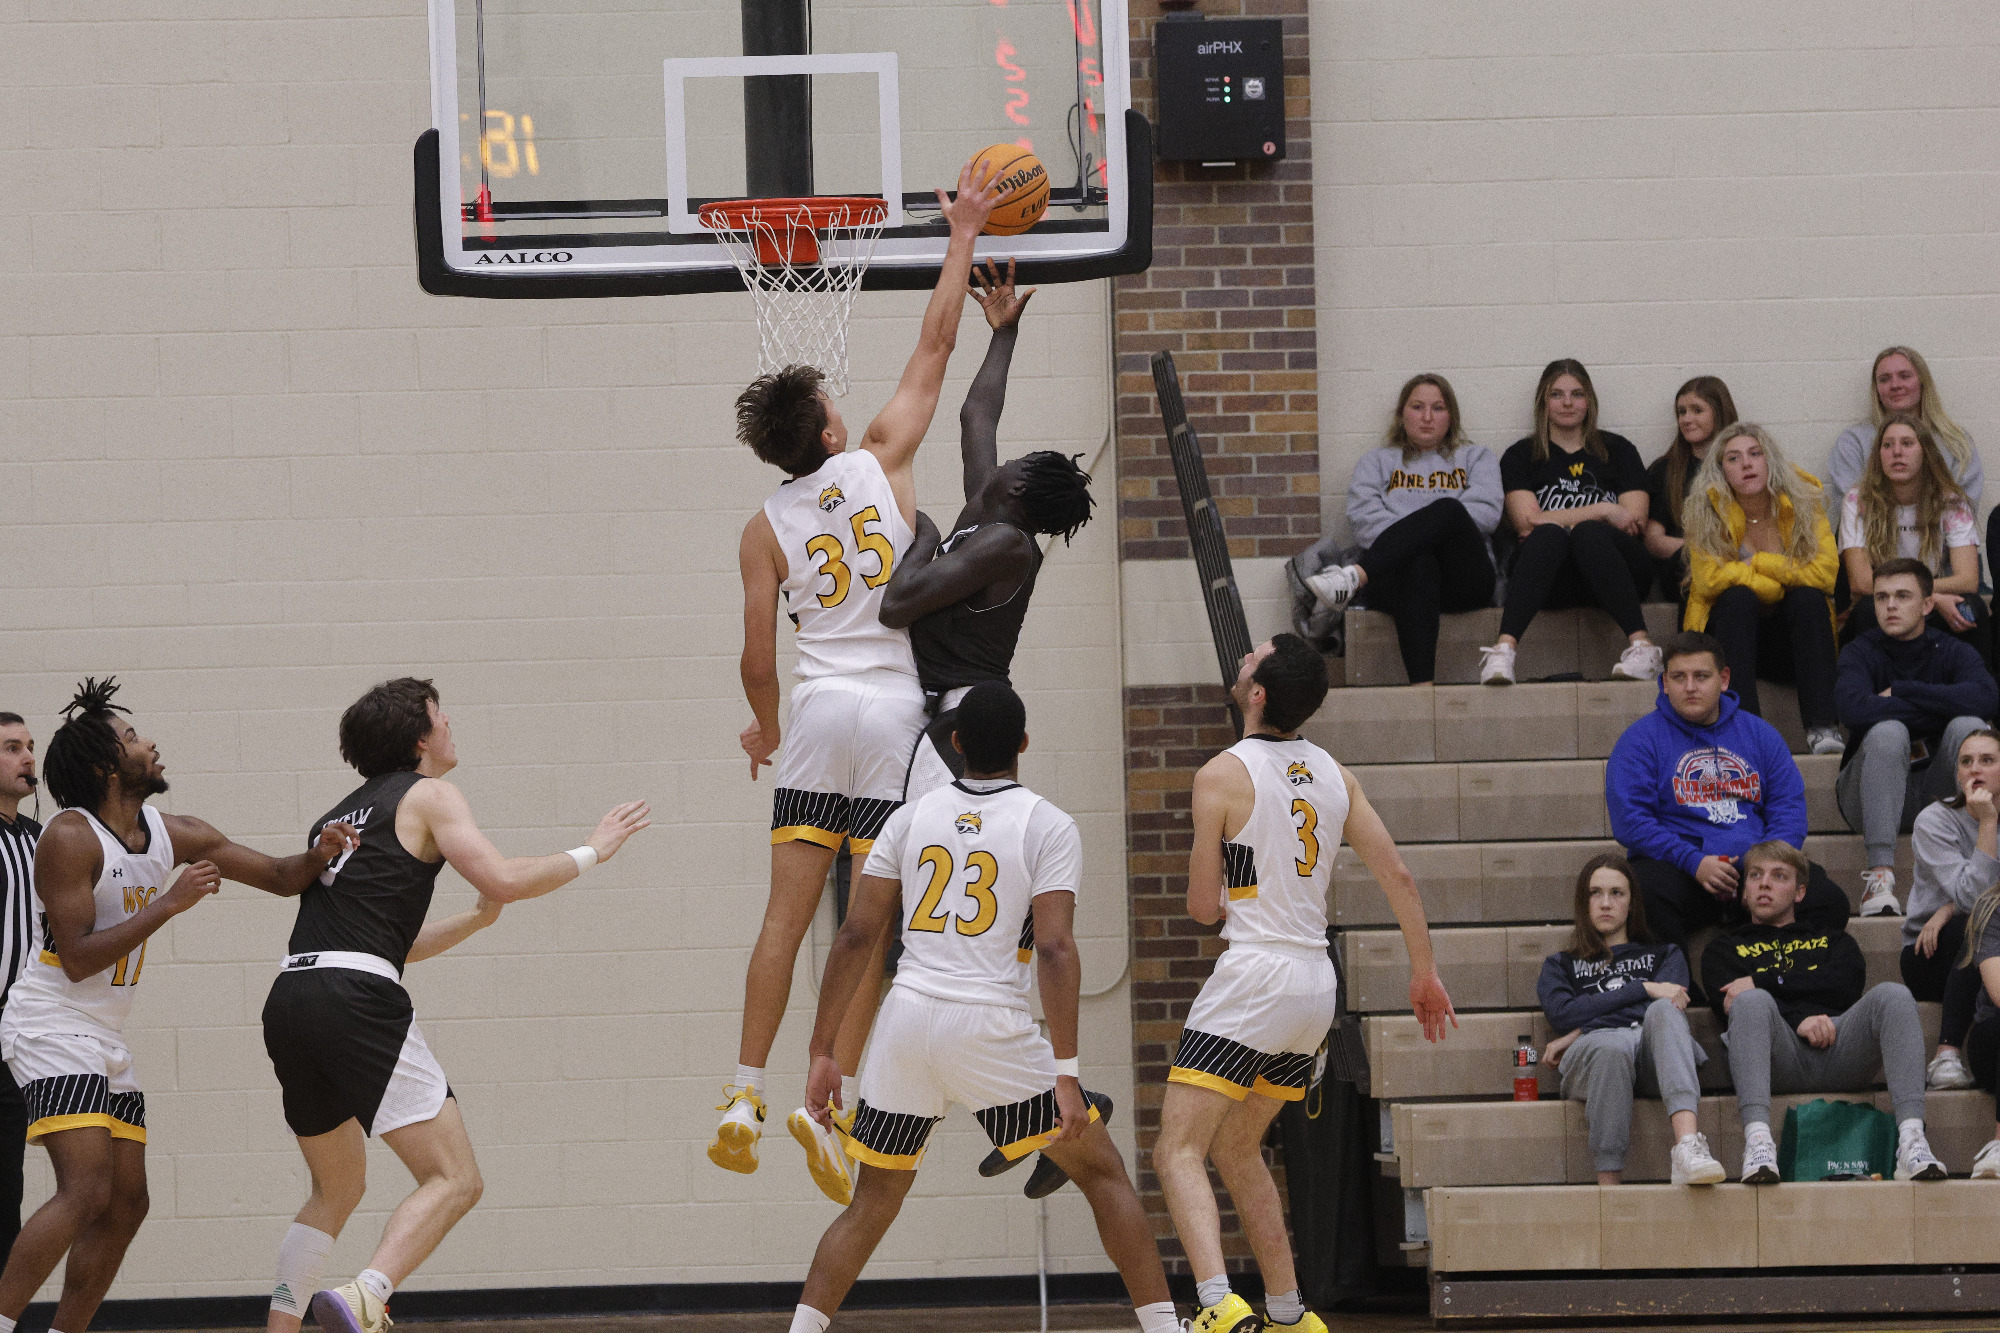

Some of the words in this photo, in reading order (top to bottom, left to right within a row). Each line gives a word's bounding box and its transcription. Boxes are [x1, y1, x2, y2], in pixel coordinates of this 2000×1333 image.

[1197, 40, 1243, 55] airPHX
[994, 164, 1045, 194] Wilson
[474, 252, 573, 265] AALCO
[805, 505, 894, 609] 35
[1290, 798, 1319, 878] 3
[122, 885, 158, 914] WSC
[908, 844, 999, 937] 23
[1782, 935, 1829, 955] STATE
[1614, 953, 1656, 974] STATE
